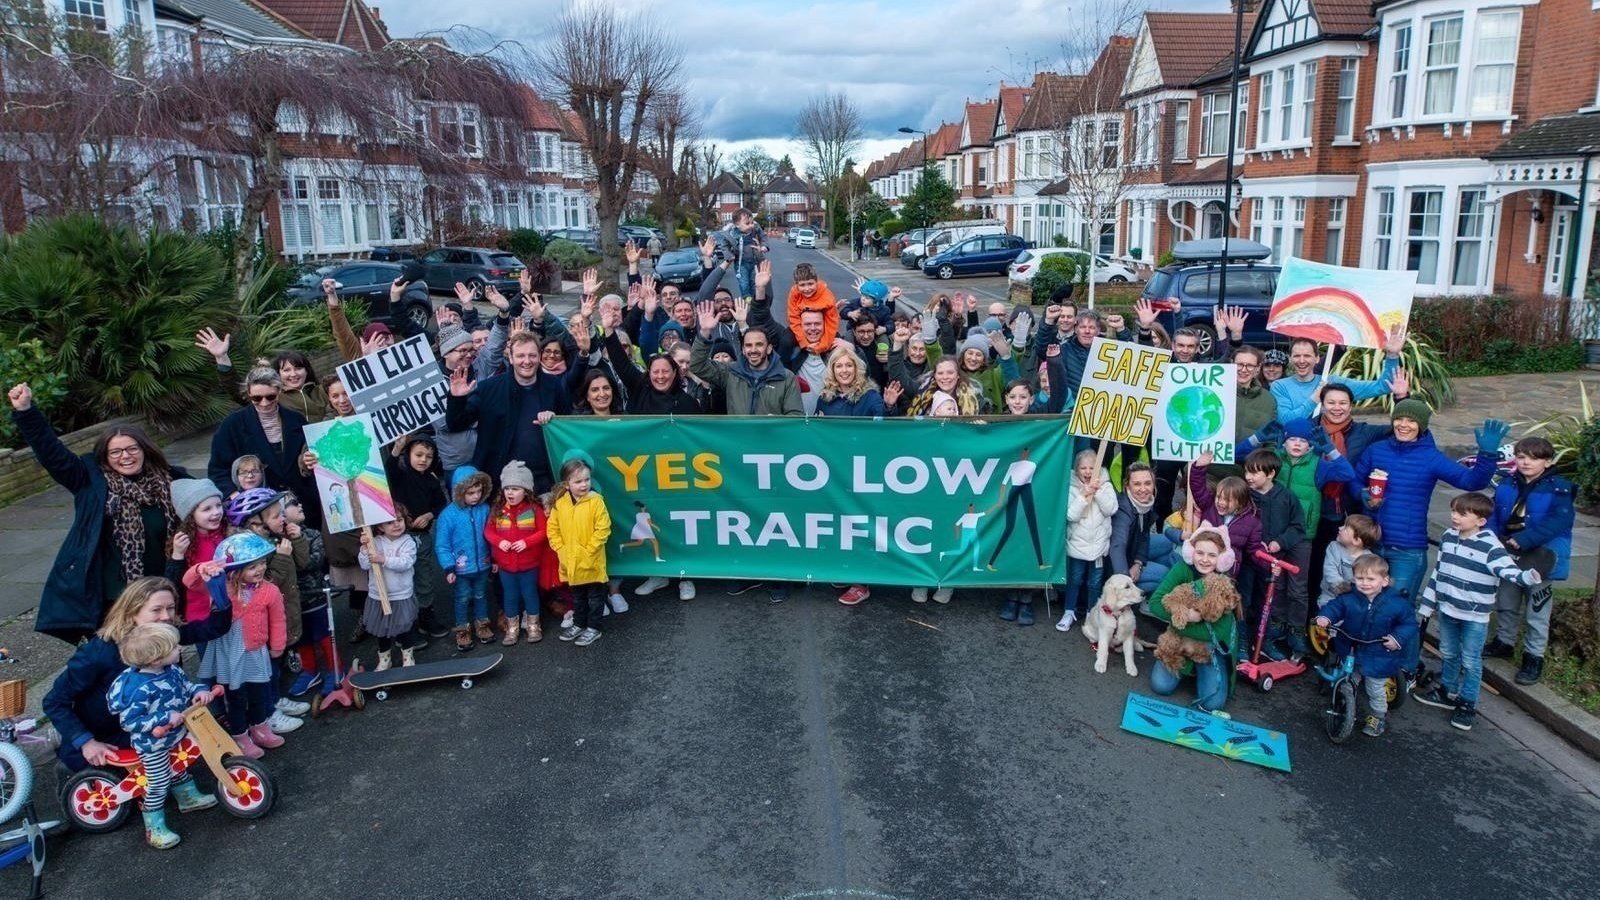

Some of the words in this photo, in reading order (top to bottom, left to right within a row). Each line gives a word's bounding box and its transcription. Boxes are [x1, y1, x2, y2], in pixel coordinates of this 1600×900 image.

[342, 358, 376, 393] NO
[377, 336, 425, 379] CUT
[1093, 343, 1171, 392] SAFE
[1171, 365, 1225, 387] OUR
[1069, 387, 1158, 446] ROADS
[607, 452, 724, 492] YES
[743, 453, 830, 492] TO
[852, 455, 1000, 495] LOW
[670, 510, 933, 554] TRAFFIC
[1532, 584, 1553, 604] NIKE
